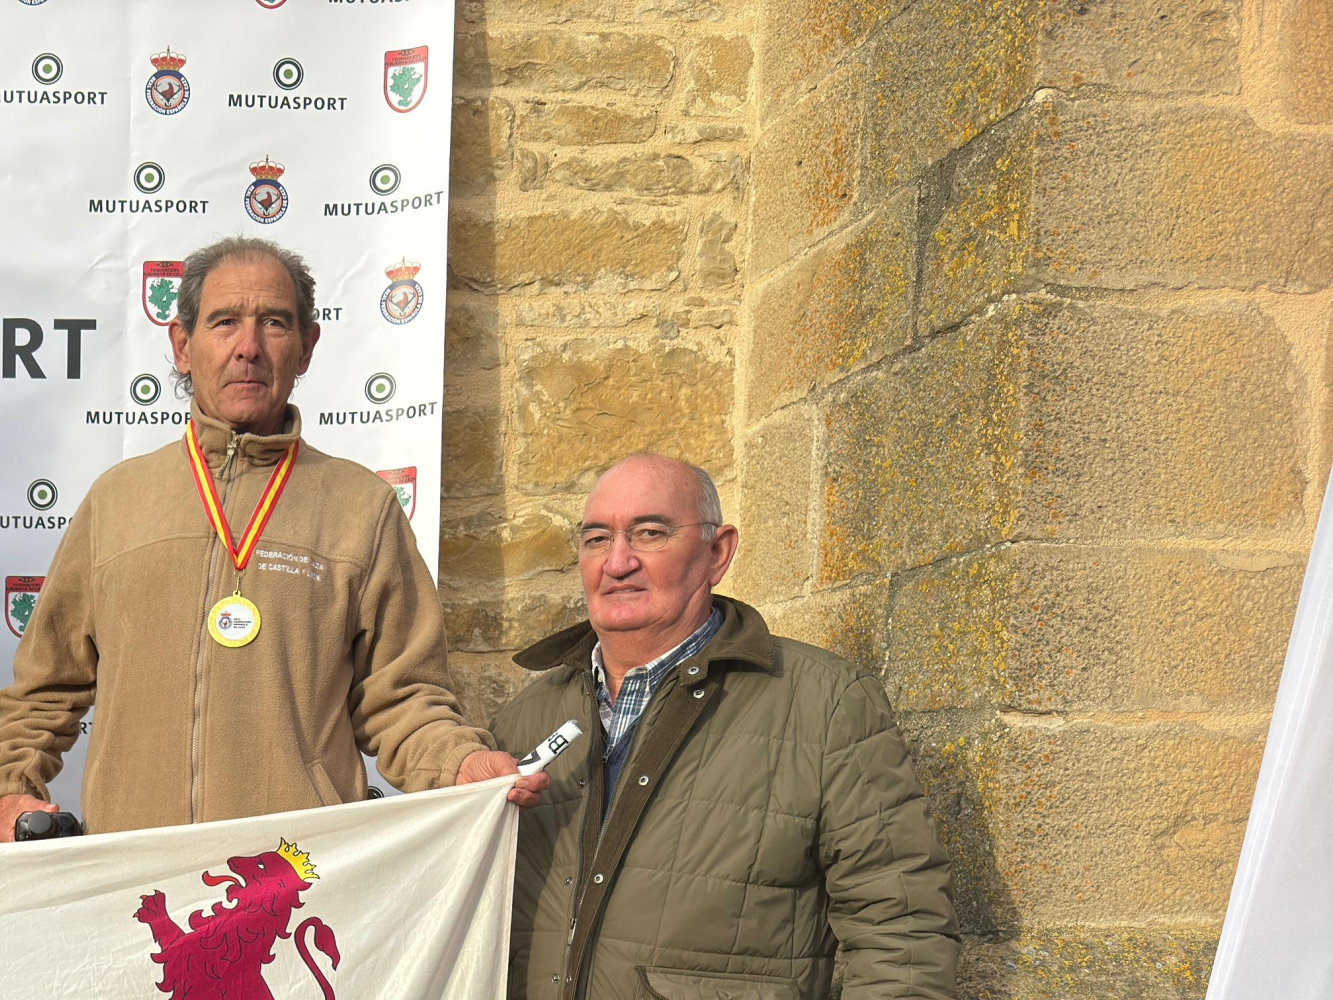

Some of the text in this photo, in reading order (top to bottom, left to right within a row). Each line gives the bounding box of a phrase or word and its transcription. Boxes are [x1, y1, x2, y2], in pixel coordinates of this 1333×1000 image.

[228, 94, 348, 111] MUTUASPORT
[89, 200, 209, 214] MUTUASPORT
[324, 190, 444, 217] MUTUASPORT
[319, 402, 437, 425] MUTUASPORT
